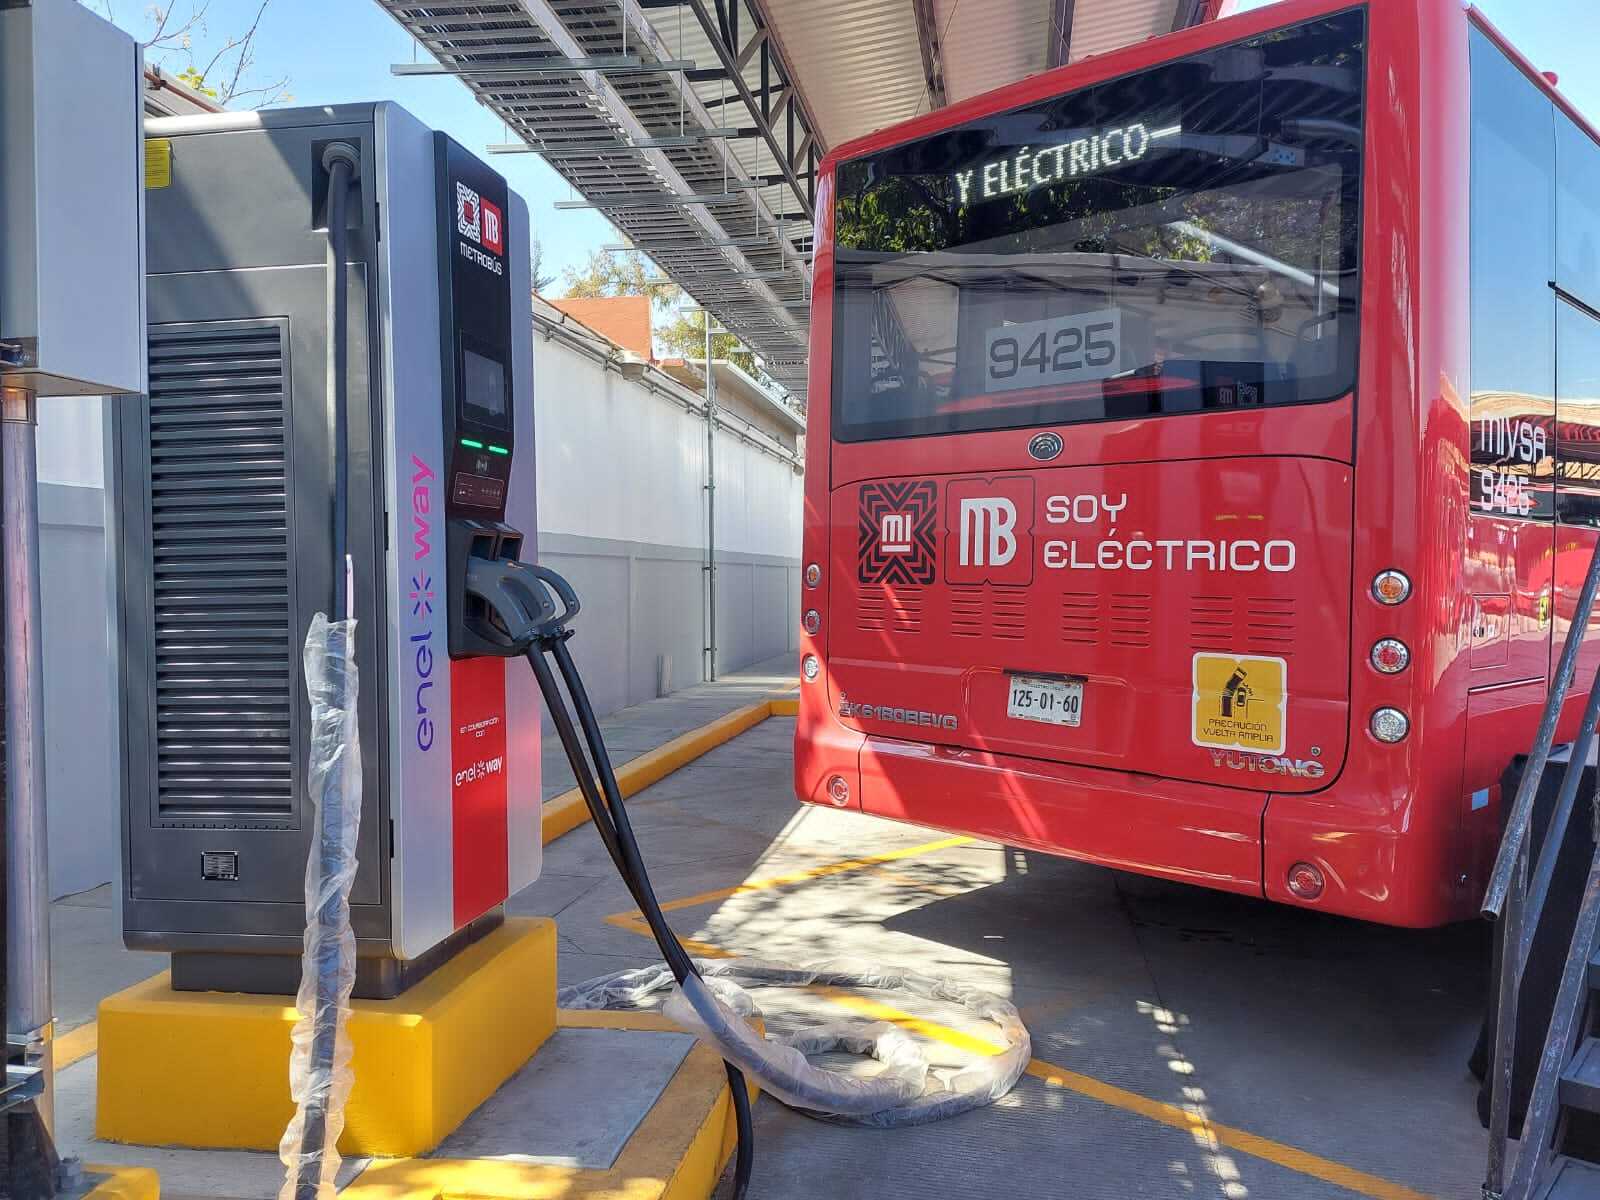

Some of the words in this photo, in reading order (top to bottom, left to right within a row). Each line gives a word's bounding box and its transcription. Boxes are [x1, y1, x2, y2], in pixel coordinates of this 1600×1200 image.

[955, 169, 974, 203] Y
[484, 208, 499, 244] MB
[460, 241, 503, 276] METROBÚS
[989, 322, 1116, 379] 9425
[410, 454, 436, 560] way
[1046, 493, 1127, 524] SOY
[1481, 470, 1530, 515] 9425
[959, 497, 1017, 566] MB
[1043, 528, 1296, 573] ELÉCTRICO
[410, 630, 434, 751] enel
[1012, 688, 1079, 714] 125-01-60
[1238, 731, 1273, 743] AMPLIA
[455, 762, 477, 786] enel
[485, 755, 503, 774] way
[1209, 748, 1325, 778] YUTONG
